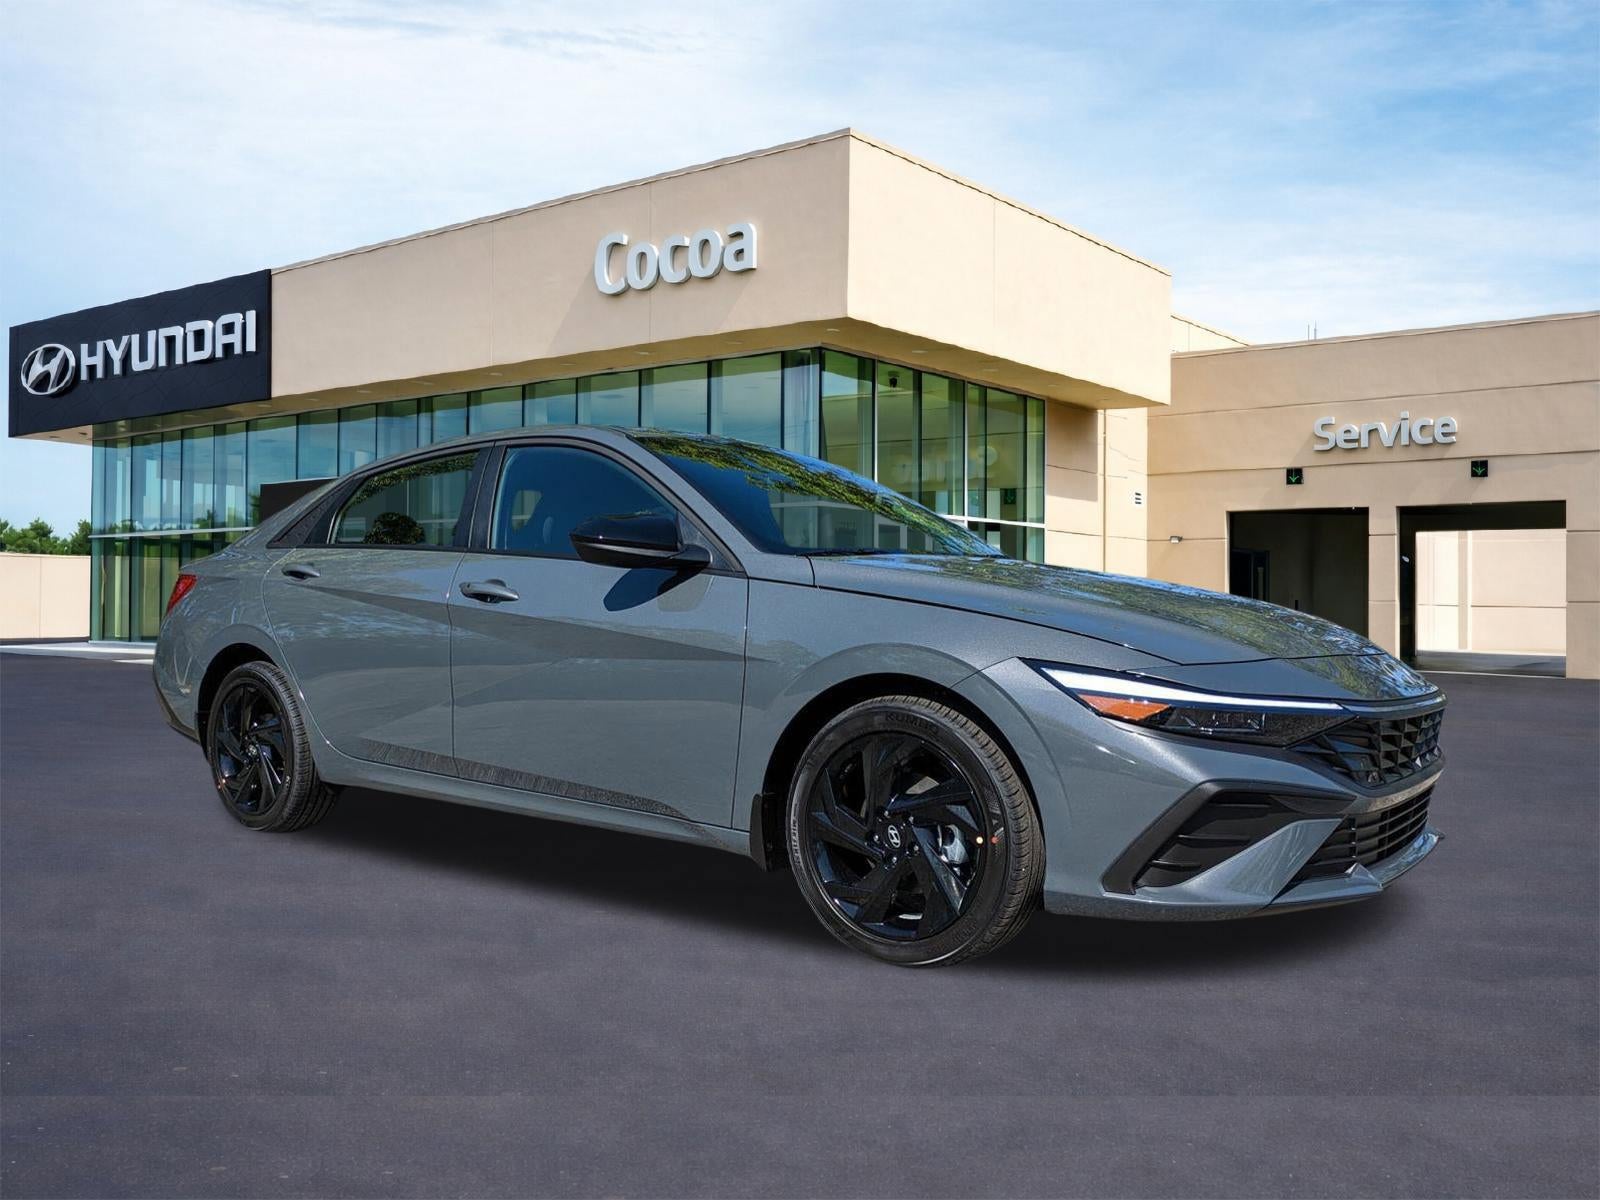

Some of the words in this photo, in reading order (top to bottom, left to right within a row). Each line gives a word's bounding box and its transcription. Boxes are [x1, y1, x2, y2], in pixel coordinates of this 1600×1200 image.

[594, 223, 757, 295] Cocoa
[81, 310, 257, 381] HYUNDAI
[1313, 411, 1458, 451] Service
